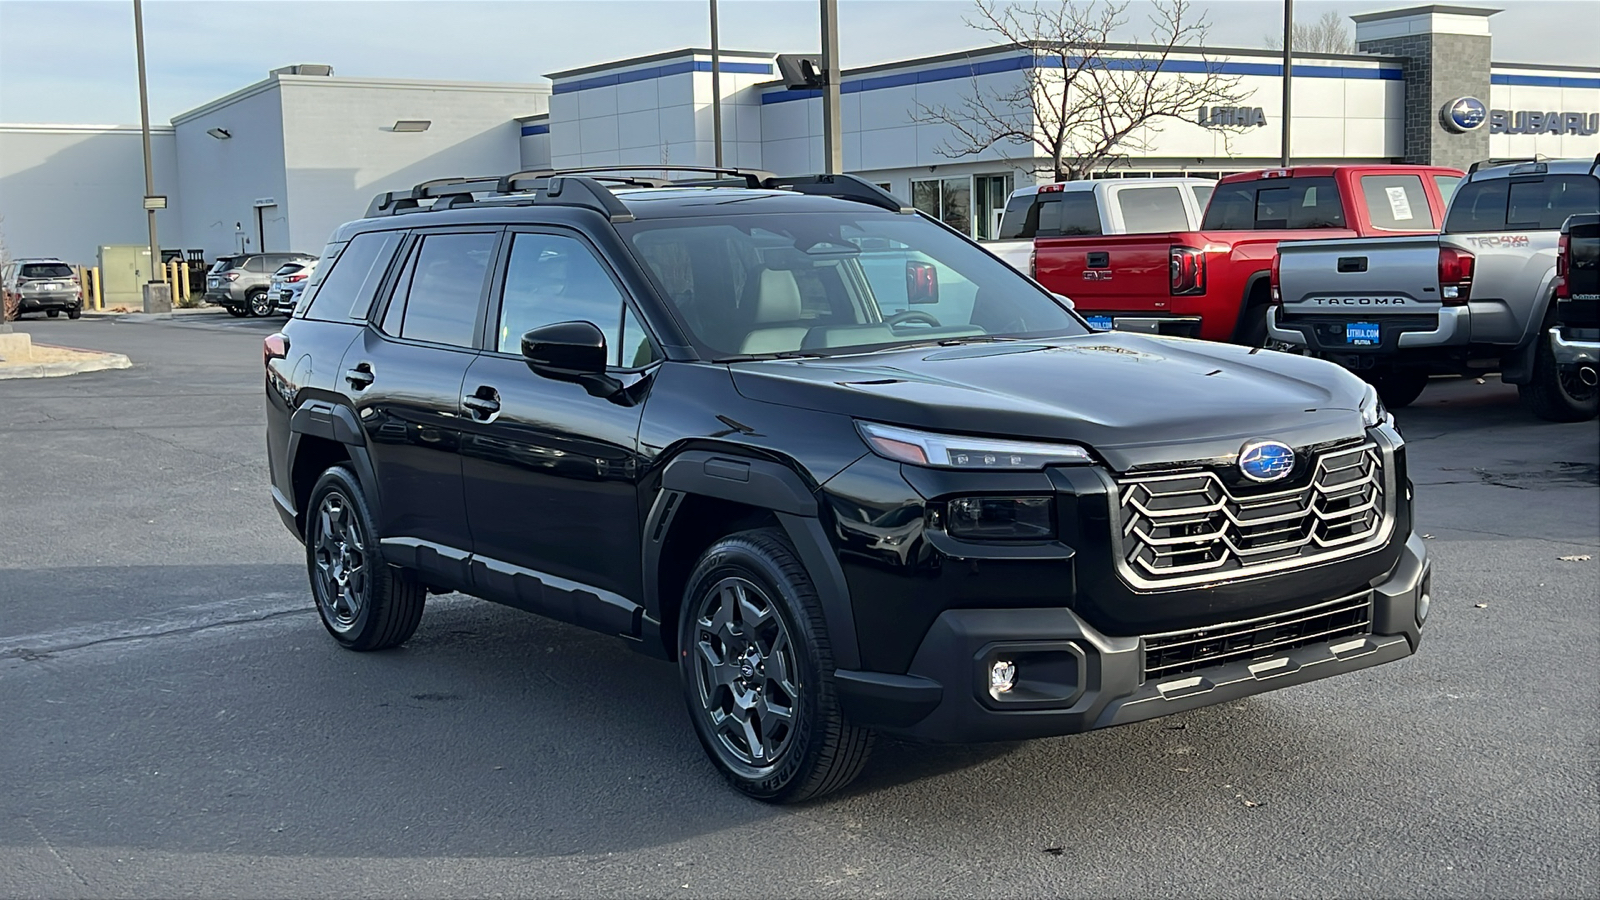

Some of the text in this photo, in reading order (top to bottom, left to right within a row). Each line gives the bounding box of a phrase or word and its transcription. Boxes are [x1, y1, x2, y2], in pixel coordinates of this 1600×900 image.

[1198, 106, 1267, 127] LITHIA
[1490, 109, 1599, 136] SUBARU
[1466, 236, 1501, 248] TRD
[1083, 270, 1112, 280] GMC
[1346, 328, 1379, 338] LITHIA.COM
